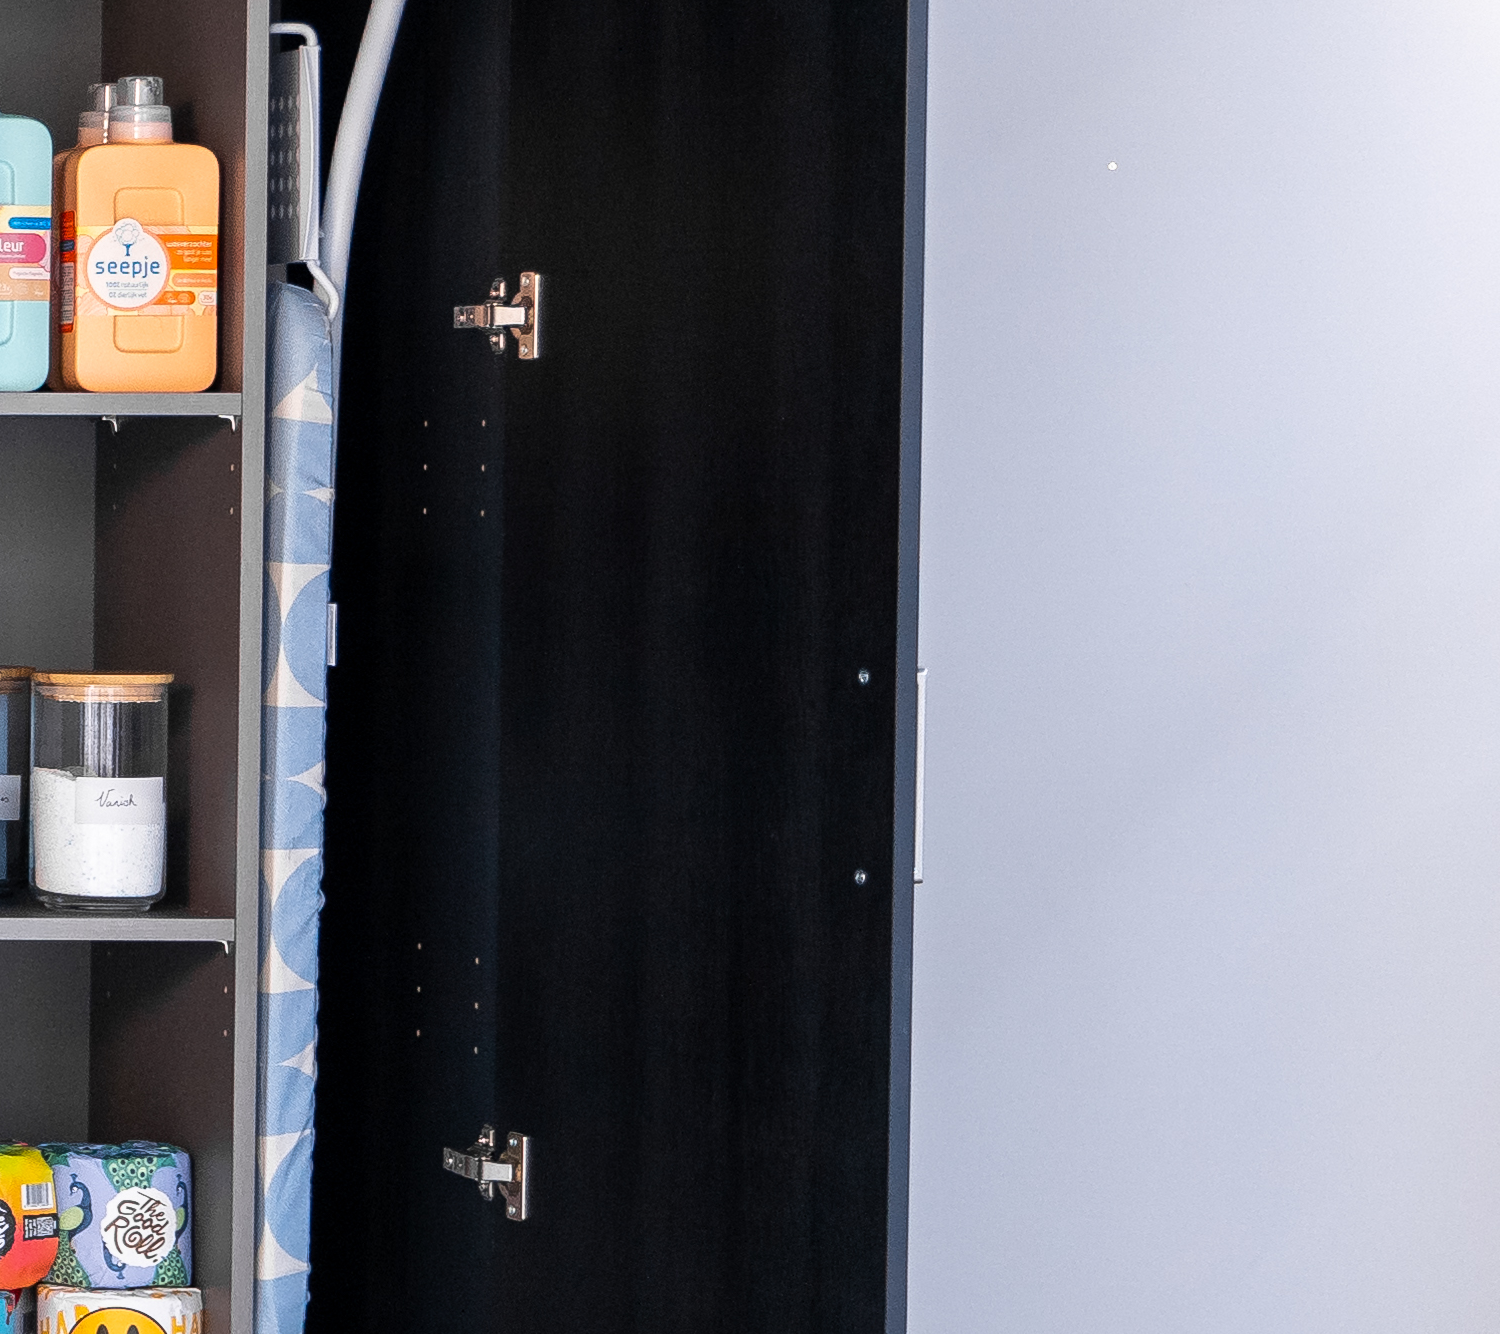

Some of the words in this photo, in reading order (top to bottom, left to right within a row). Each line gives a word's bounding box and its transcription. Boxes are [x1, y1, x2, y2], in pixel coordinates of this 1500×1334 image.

[95, 255, 161, 279] seepje
[94, 788, 138, 808] Vanish
[116, 1199, 170, 1237] Good
[137, 1191, 167, 1222] The
[104, 1216, 168, 1264] Roll.
